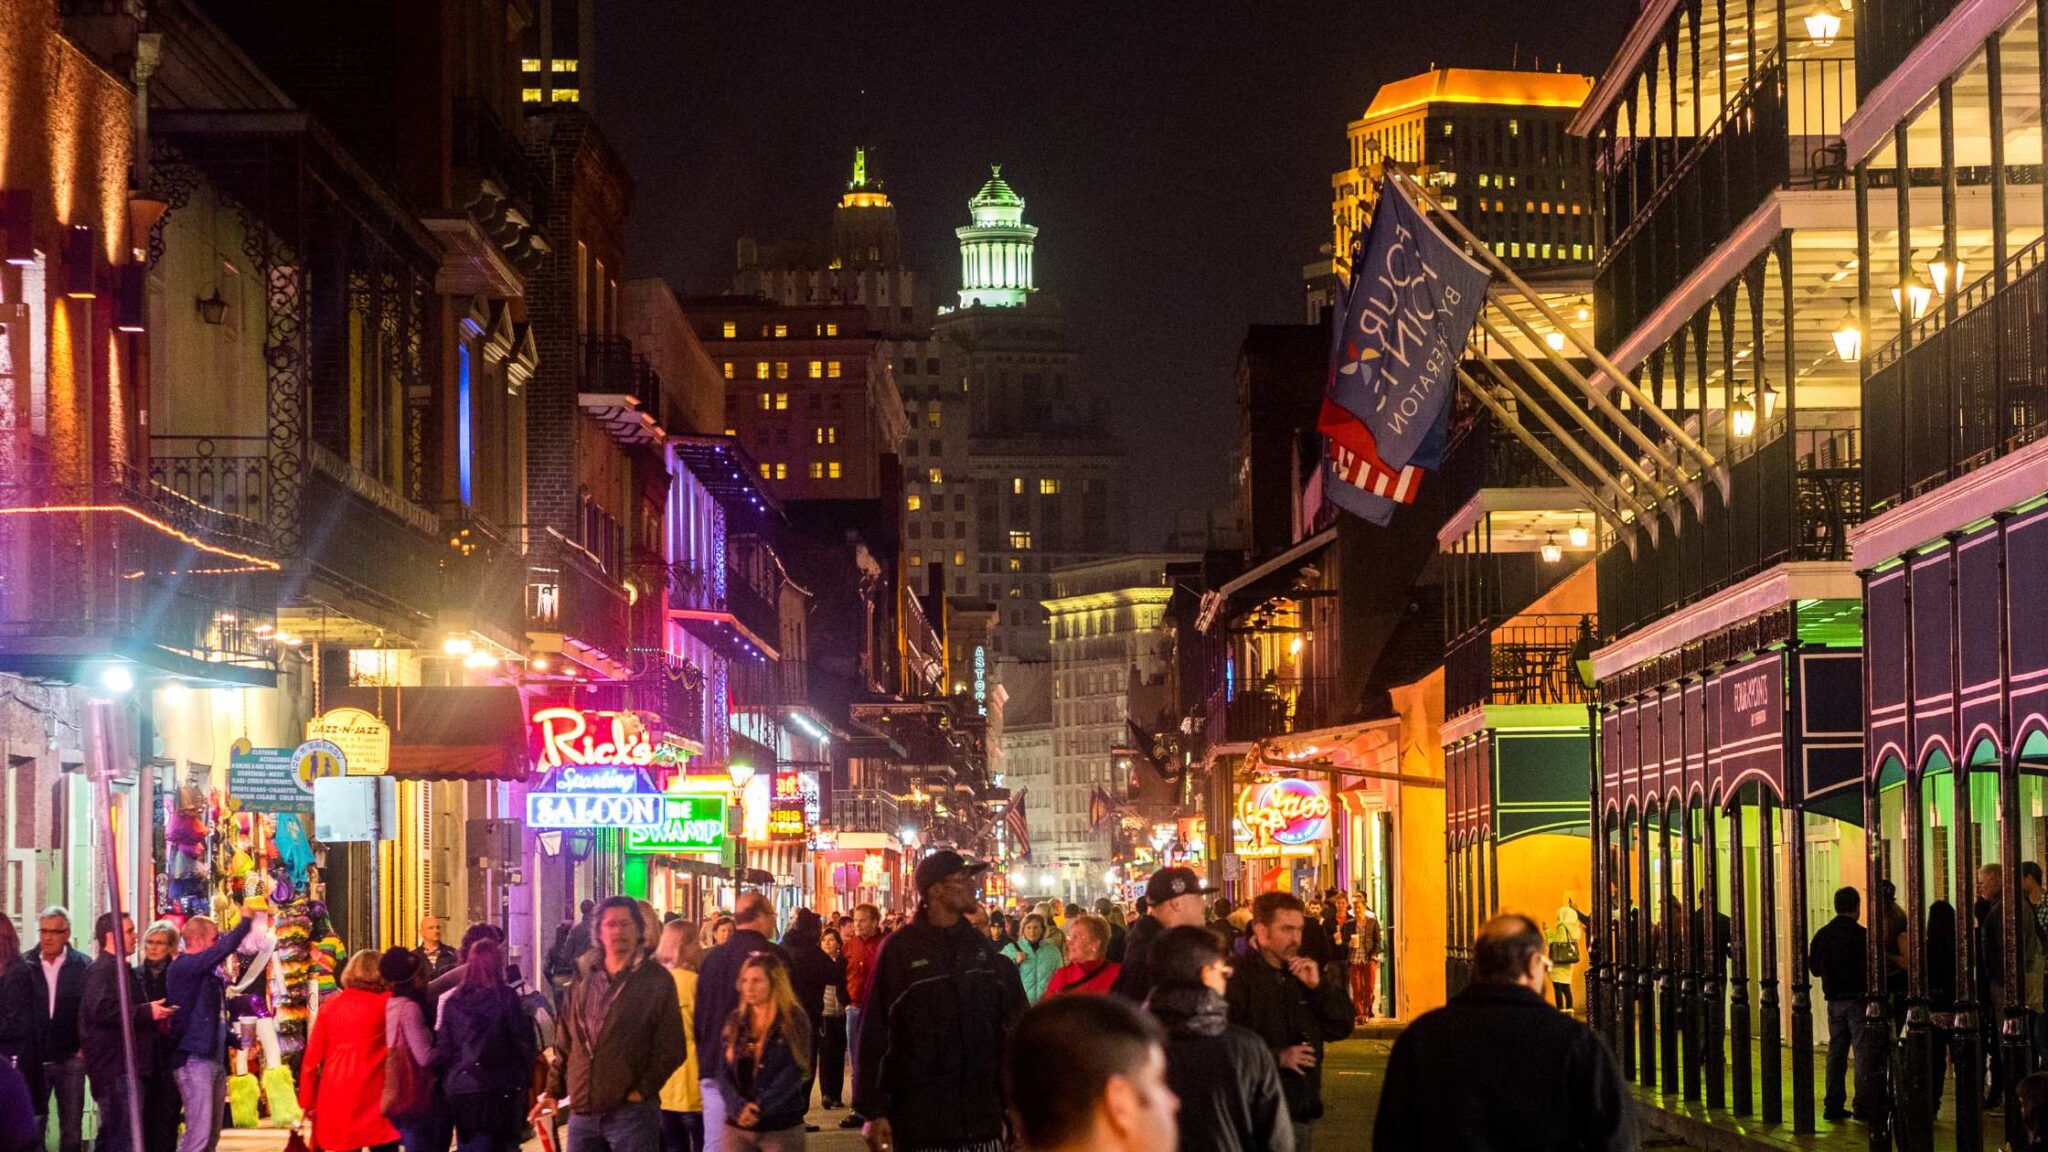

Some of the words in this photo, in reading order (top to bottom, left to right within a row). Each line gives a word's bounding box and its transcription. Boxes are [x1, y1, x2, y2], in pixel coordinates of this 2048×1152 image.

[532, 707, 652, 767] Rick's
[558, 768, 634, 792] Sporting
[537, 797, 654, 824] SALOON
[667, 801, 692, 819] HE
[769, 811, 801, 821] HRIS
[631, 819, 722, 843] SWAMP
[768, 822, 804, 833] WENS
